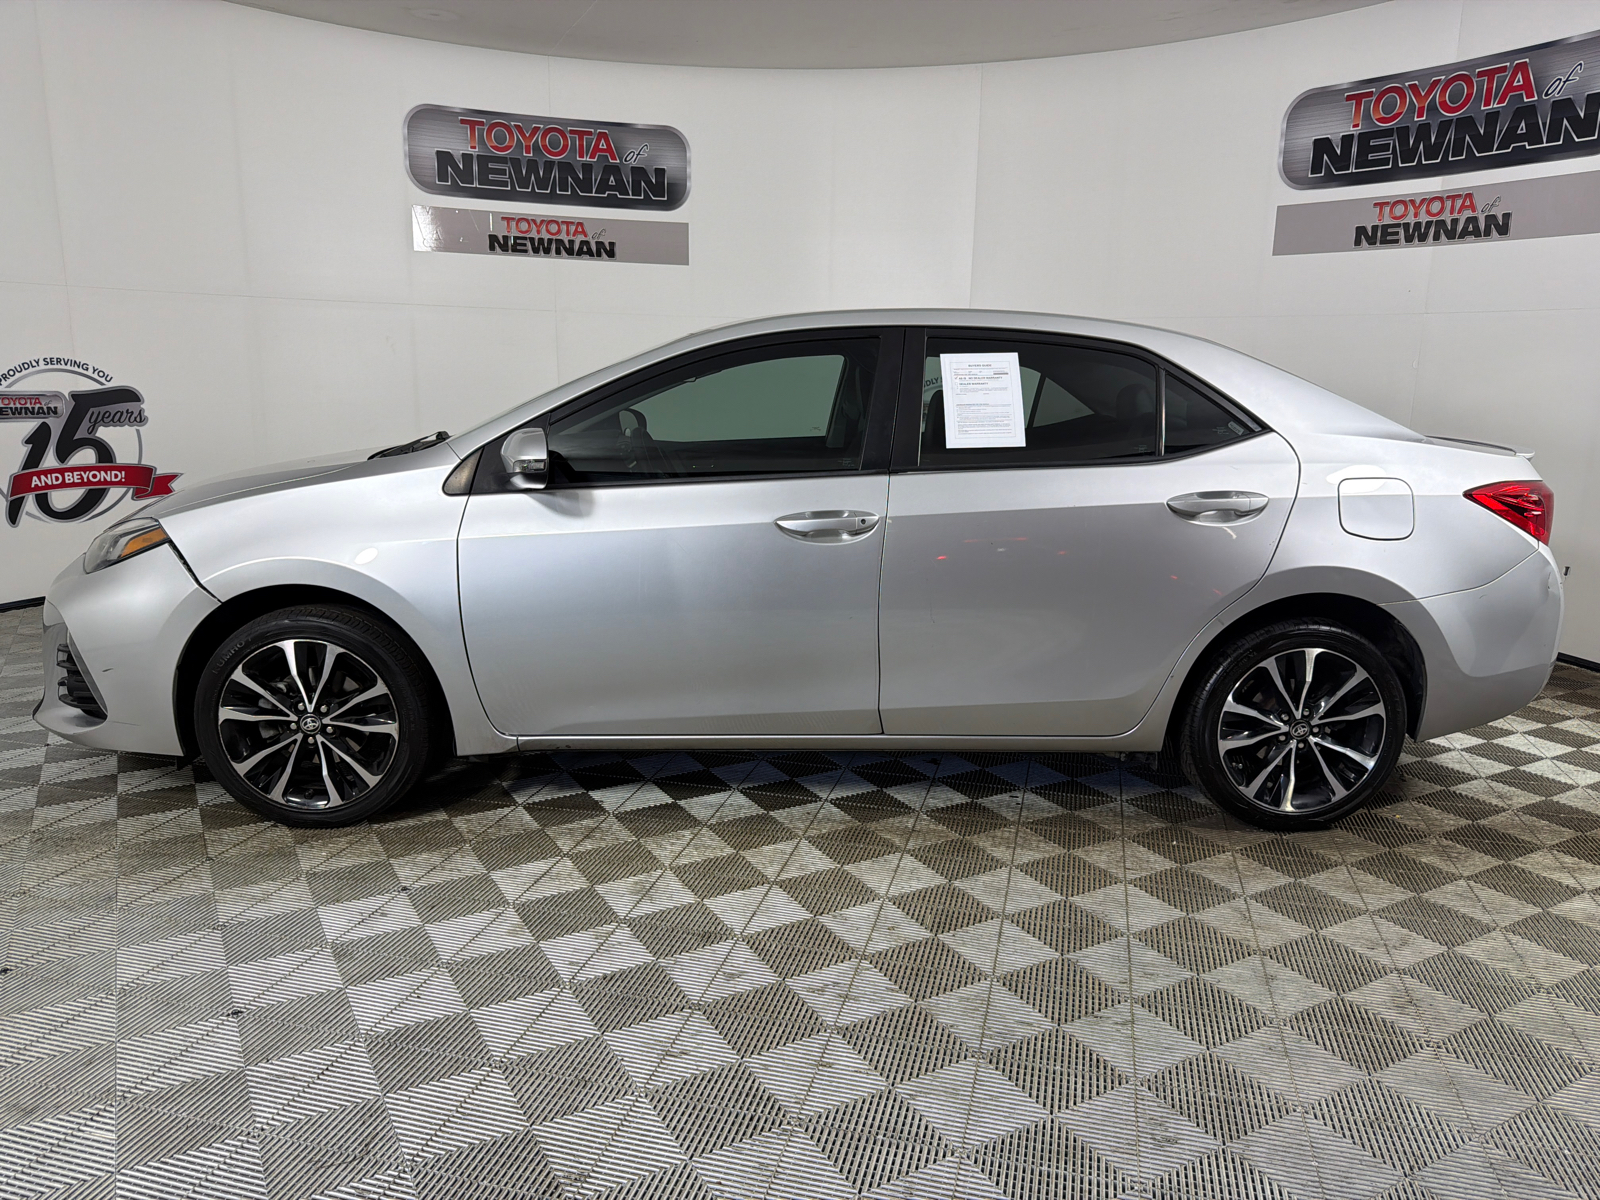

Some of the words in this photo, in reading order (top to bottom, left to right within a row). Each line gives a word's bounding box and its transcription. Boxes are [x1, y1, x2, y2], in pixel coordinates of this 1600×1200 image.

[1345, 58, 1538, 130] TOYOTA
[1543, 61, 1584, 99] of
[459, 117, 619, 162] TOYOTA
[623, 143, 649, 164] of
[1308, 91, 1600, 177] NEWNAN
[435, 149, 667, 200] NEWNAN
[1373, 191, 1477, 222] TOYOTA
[1481, 196, 1501, 214] of
[501, 216, 588, 238] TOYOTA
[591, 228, 606, 240] of
[1353, 211, 1512, 248] NEWNAN
[488, 234, 617, 259] NEWNAN
[42, 357, 90, 371] SERVING
[91, 366, 114, 383] YOU
[0, 396, 42, 406] OYOTA
[0, 406, 58, 416] EWNAN
[87, 408, 146, 435] years
[31, 473, 63, 488] AND
[64, 471, 126, 483] BEYOND!
